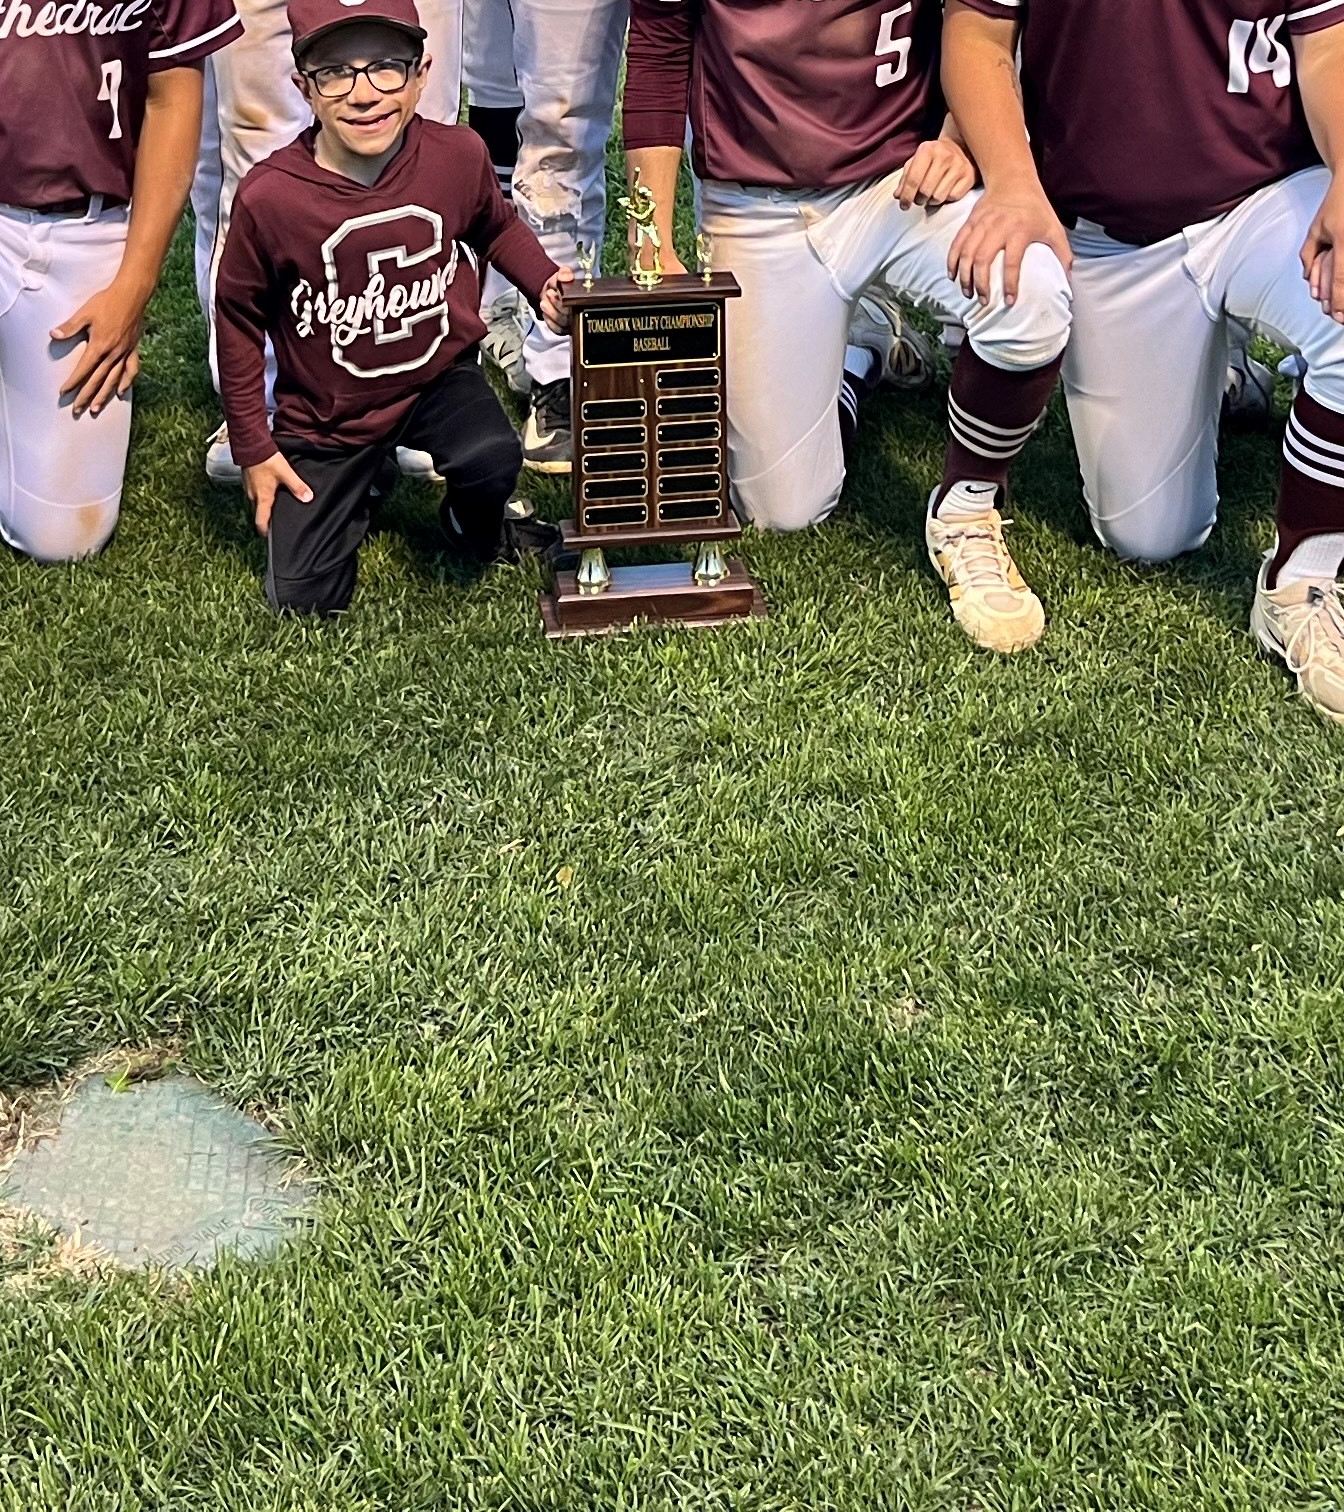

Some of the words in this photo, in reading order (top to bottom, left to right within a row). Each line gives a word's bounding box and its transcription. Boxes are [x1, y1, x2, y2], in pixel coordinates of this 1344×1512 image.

[875, 1, 912, 88] 5
[1226, 14, 1293, 94] 14
[320, 203, 450, 379] C
[587, 317, 631, 334] TOMAHAWK
[631, 315, 660, 331] VALLEY
[660, 313, 715, 330] CHAMPIONSHIP
[633, 336, 672, 352] BASEBALL
